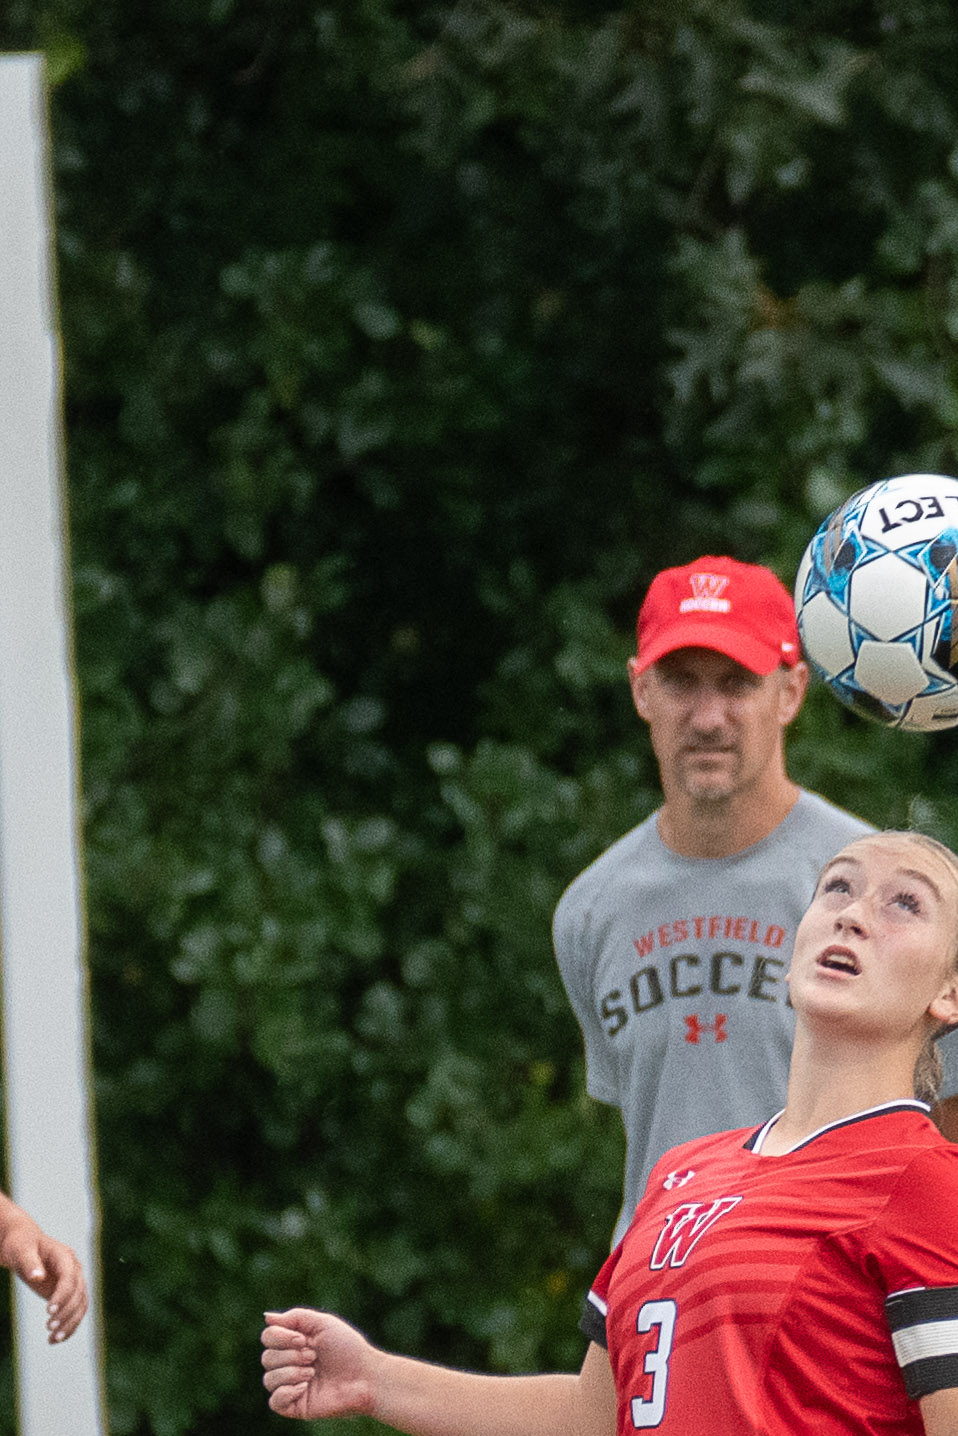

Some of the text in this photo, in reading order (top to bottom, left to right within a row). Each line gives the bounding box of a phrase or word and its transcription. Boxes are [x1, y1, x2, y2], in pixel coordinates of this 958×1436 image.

[633, 915, 786, 958] WESTFIELD
[601, 951, 794, 1037] SOCCE
[650, 1196, 744, 1271] W
[630, 1297, 677, 1430] 3
